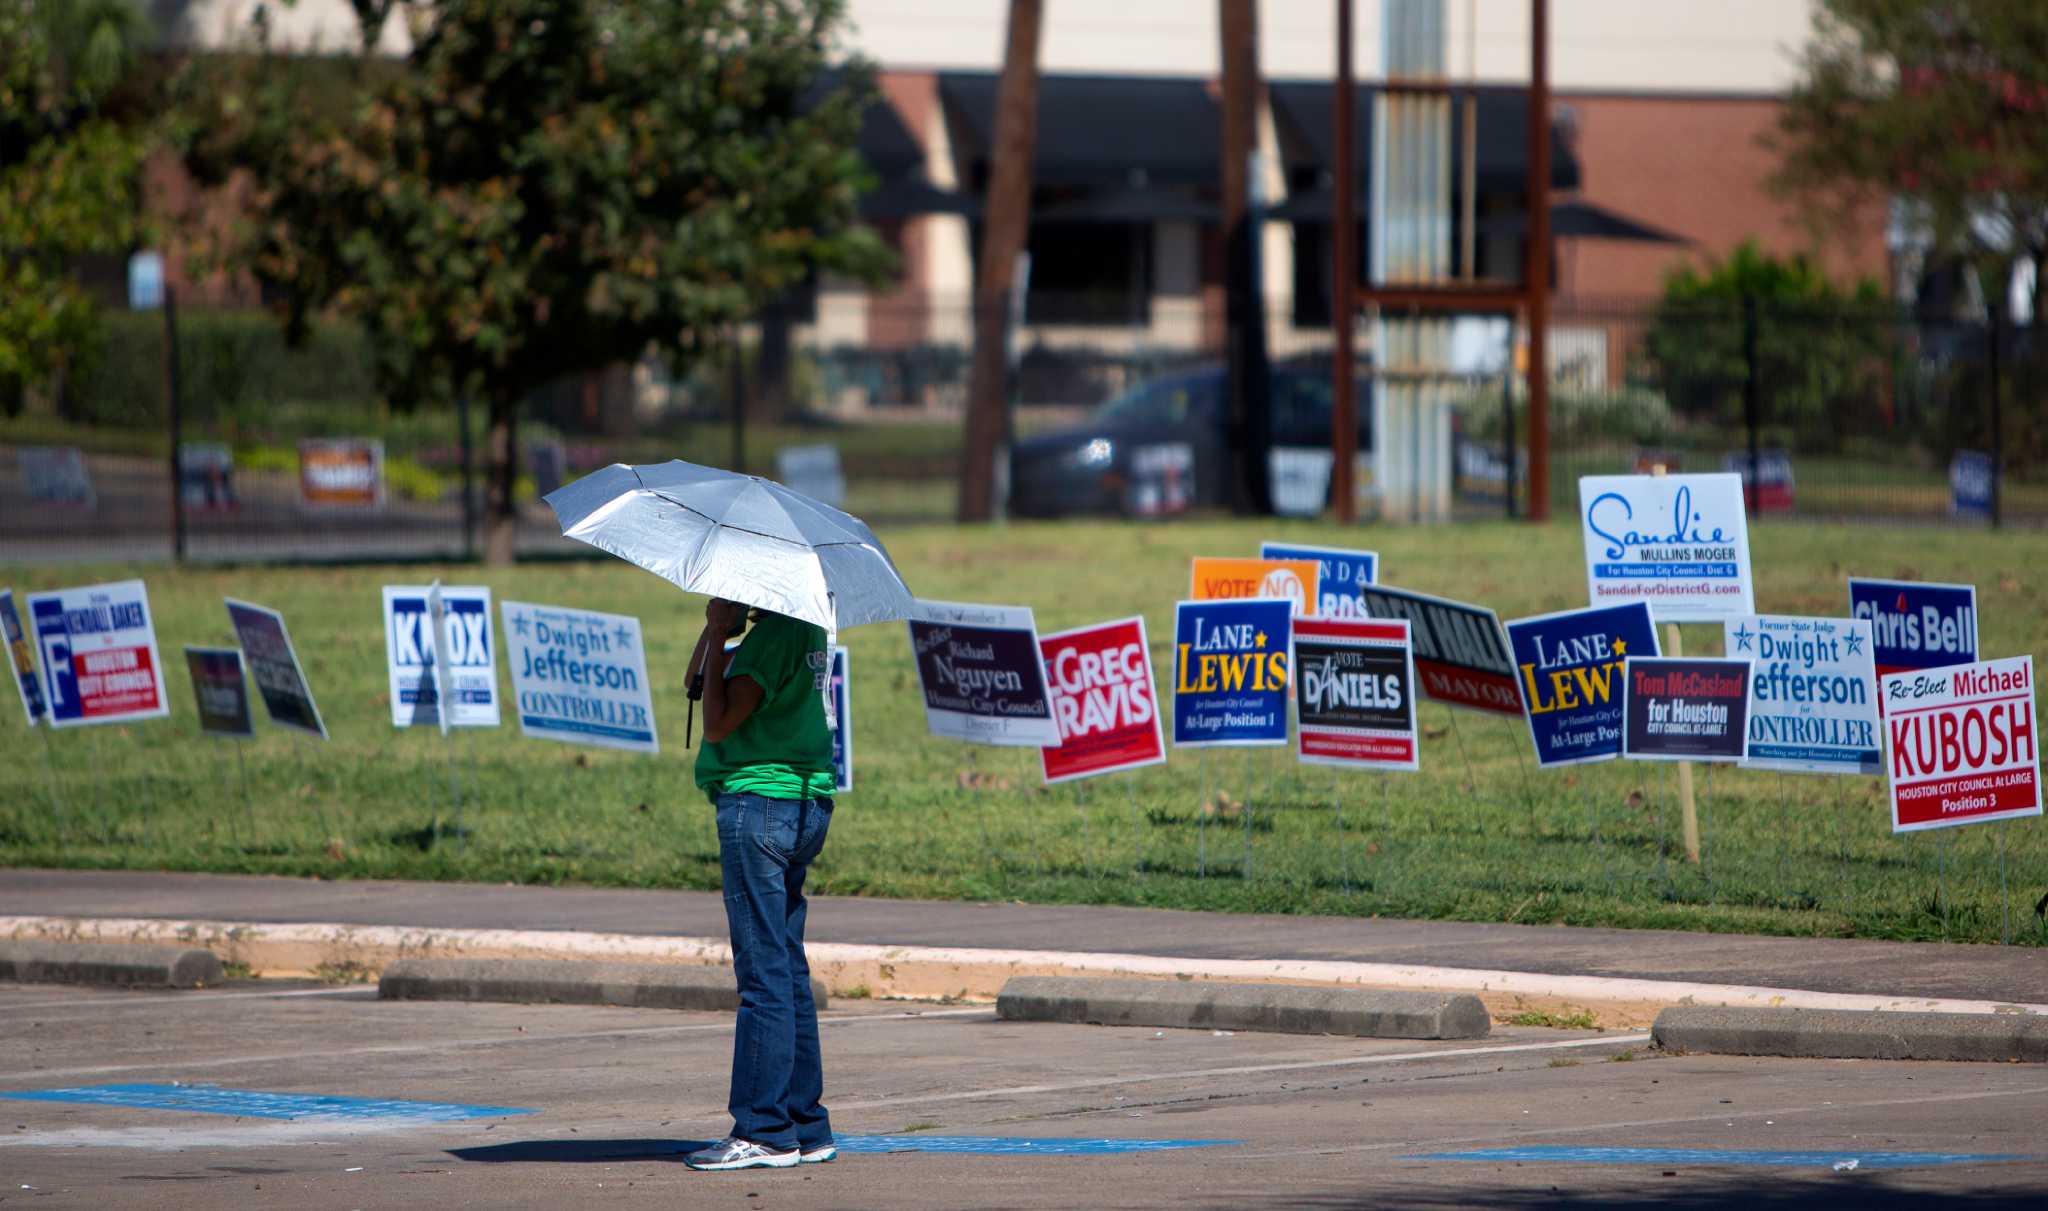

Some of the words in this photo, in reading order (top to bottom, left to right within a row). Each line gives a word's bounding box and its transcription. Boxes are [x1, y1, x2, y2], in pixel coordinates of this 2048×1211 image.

[1588, 485, 1735, 560] Sandie
[1641, 547, 1691, 561] MULLINS
[1694, 547, 1736, 561] MOGER
[1204, 578, 1256, 599] VOTE
[1265, 577, 1299, 598] NO
[1320, 560, 1368, 585] NDA
[1608, 566, 1620, 576] For
[1623, 566, 1654, 576] Houston
[1656, 566, 1672, 577] City
[1597, 582, 1740, 596] SandieForDistrictG.com
[536, 621, 611, 656] Dwight
[1194, 617, 1254, 651] LANE
[1759, 618, 1789, 631] Former
[1791, 620, 1810, 632] State
[1813, 620, 1836, 634] Judge
[1922, 605, 1974, 654] Bell
[949, 640, 995, 661] Richard
[1334, 651, 1364, 667] VOTE
[1533, 633, 1611, 669] LANE
[1759, 632, 1839, 669] Dwight
[522, 646, 638, 690] Jefferson
[933, 653, 1023, 698] Nguyen
[1055, 643, 1145, 694] GREG
[1176, 643, 1288, 694] LEWIS
[1304, 656, 1402, 713] DANIELS
[1634, 671, 1665, 696] Tom
[1667, 671, 1744, 697] McCasland
[1754, 661, 1866, 705] efferson
[1889, 676, 1947, 700] Re-Elect
[1953, 662, 2029, 698] Michael
[1427, 671, 1519, 706] MAYOR
[1520, 660, 1625, 715] LEW
[521, 690, 648, 727] CONTROLLER
[997, 697, 1045, 714] Council
[1185, 712, 1222, 732] At-Large
[1223, 711, 1267, 727] Position
[1648, 698, 1670, 723] for
[1672, 698, 1728, 724] Houston
[1551, 731, 1597, 748] At-Large
[1648, 722, 1664, 735] CITY
[1664, 722, 1692, 735] COUNCIL
[1750, 714, 1875, 747] ONTROLLER
[1891, 701, 2034, 779] KUBOSH
[1899, 785, 1938, 800] HOUSTON
[1939, 782, 1958, 795] CITY
[1958, 778, 1994, 792] COUNCIL
[2005, 772, 2033, 787] LARGE
[1941, 797, 1987, 813] Position
[1990, 794, 1997, 807] 3
